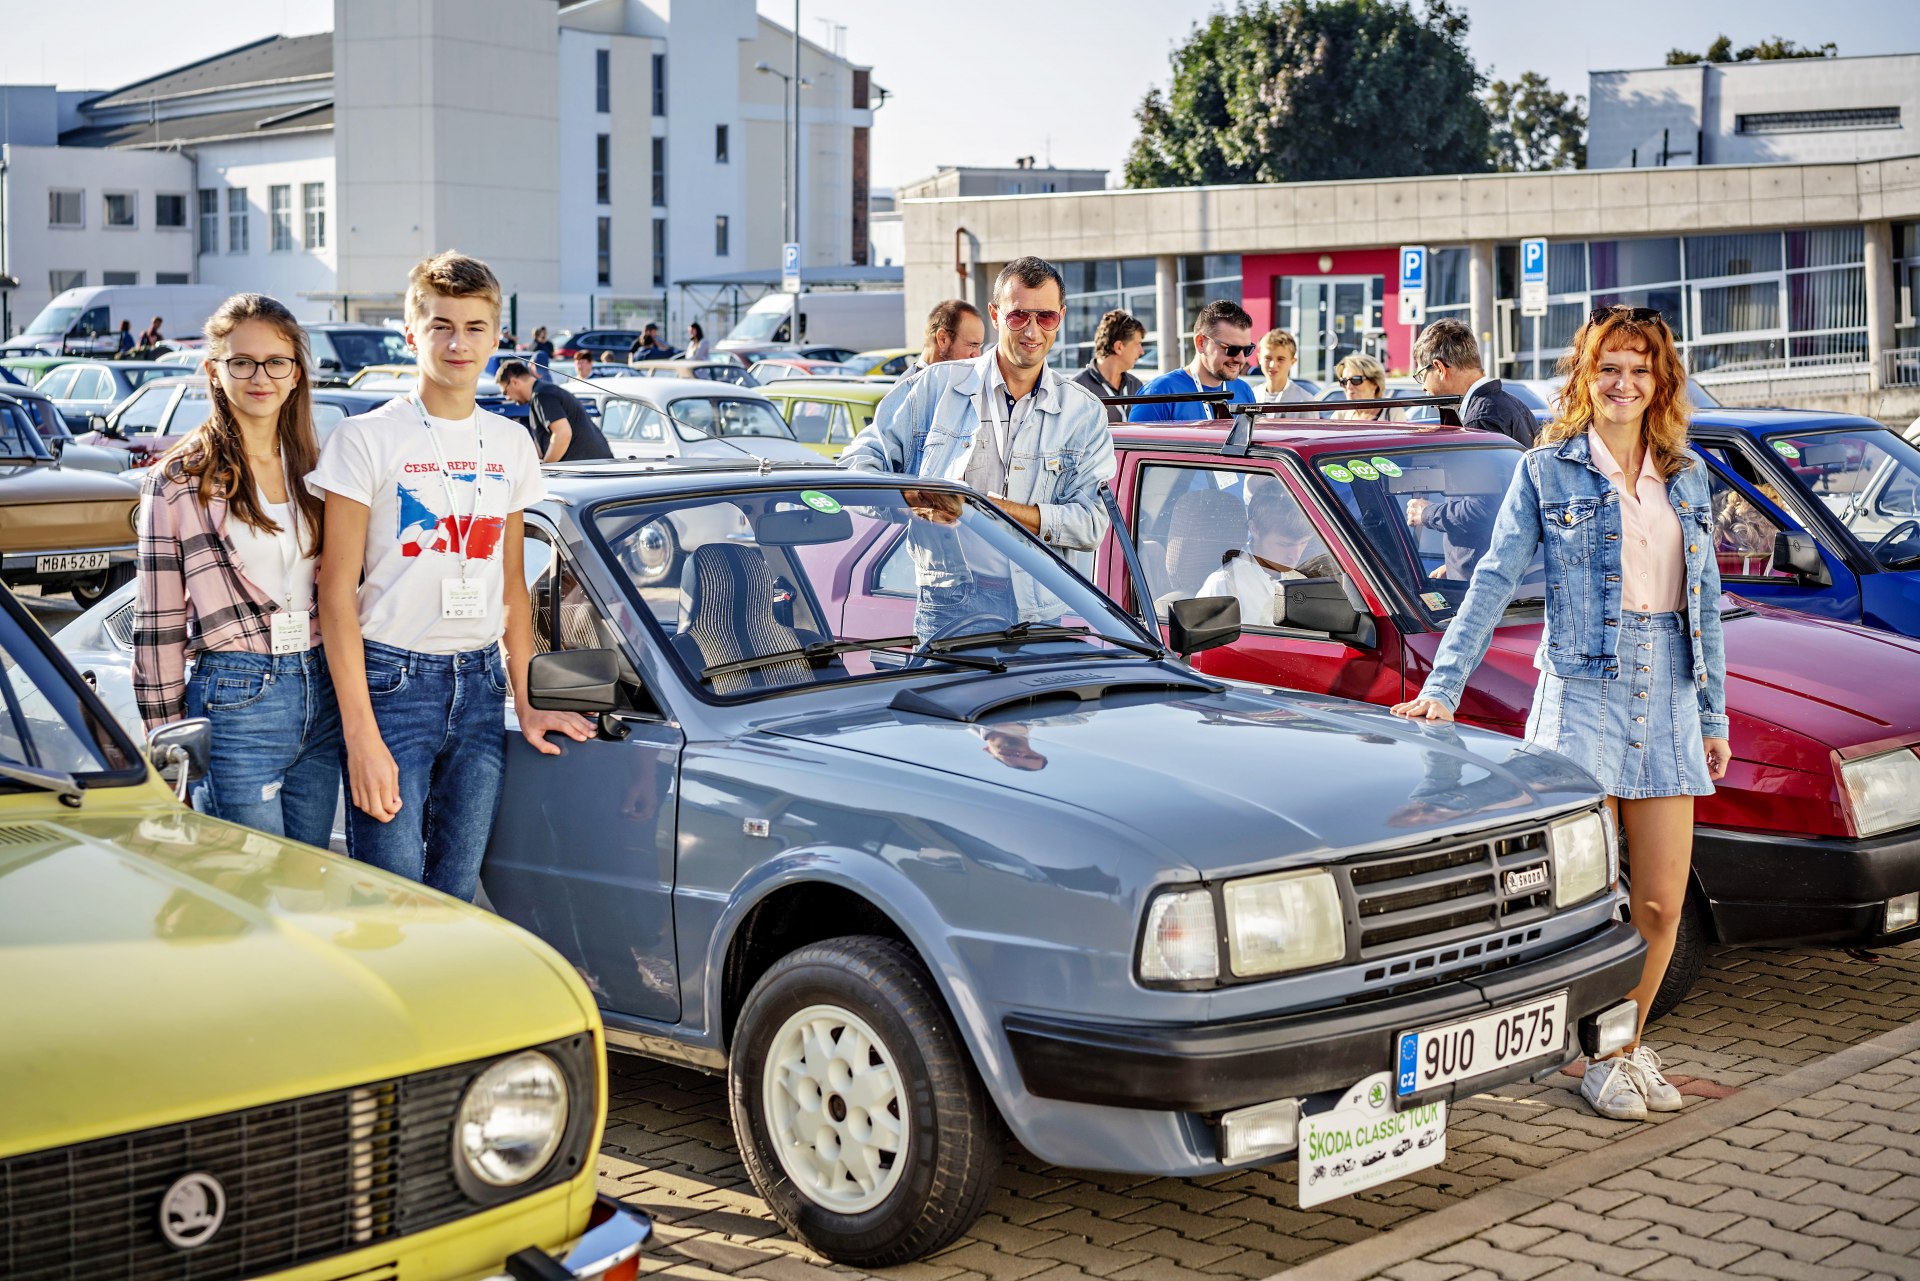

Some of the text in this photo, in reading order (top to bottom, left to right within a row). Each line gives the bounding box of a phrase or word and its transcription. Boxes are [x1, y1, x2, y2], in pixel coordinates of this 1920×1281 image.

[787, 247, 797, 269] P
[1527, 243, 1541, 269] P
[1405, 252, 1420, 279] P
[404, 462, 440, 473] ČESK
[1330, 469, 1348, 478] 69
[1351, 466, 1377, 475] 102
[1375, 463, 1400, 472] 104
[809, 496, 834, 508] 95
[1424, 1004, 1555, 1081] 9U0 0575
[1400, 1071, 1415, 1088] CZ
[1308, 1102, 1438, 1162] ŠKODA CLASSIC TOUR
